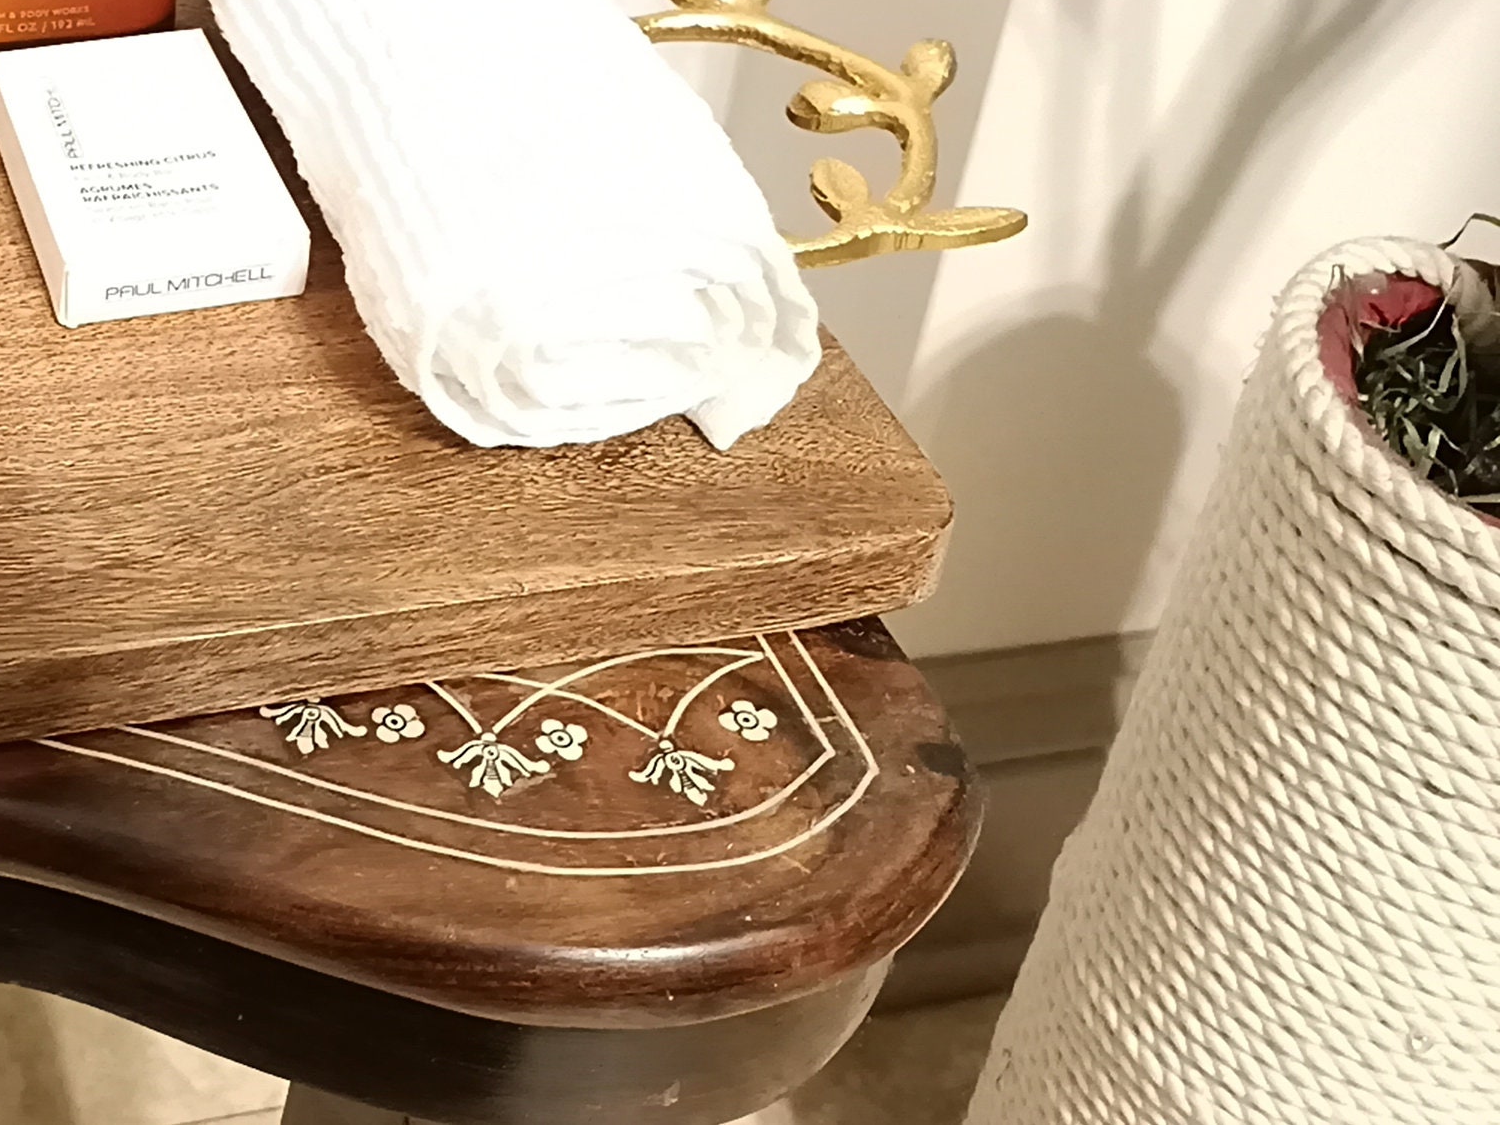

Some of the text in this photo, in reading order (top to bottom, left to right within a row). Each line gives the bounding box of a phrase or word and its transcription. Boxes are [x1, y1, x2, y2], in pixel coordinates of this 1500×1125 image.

[17, 22, 38, 33] OZ
[69, 150, 217, 171] REFRESHING CITRUS
[79, 182, 153, 195] AGRUMES
[105, 267, 274, 300] PAUL MITCHELL
